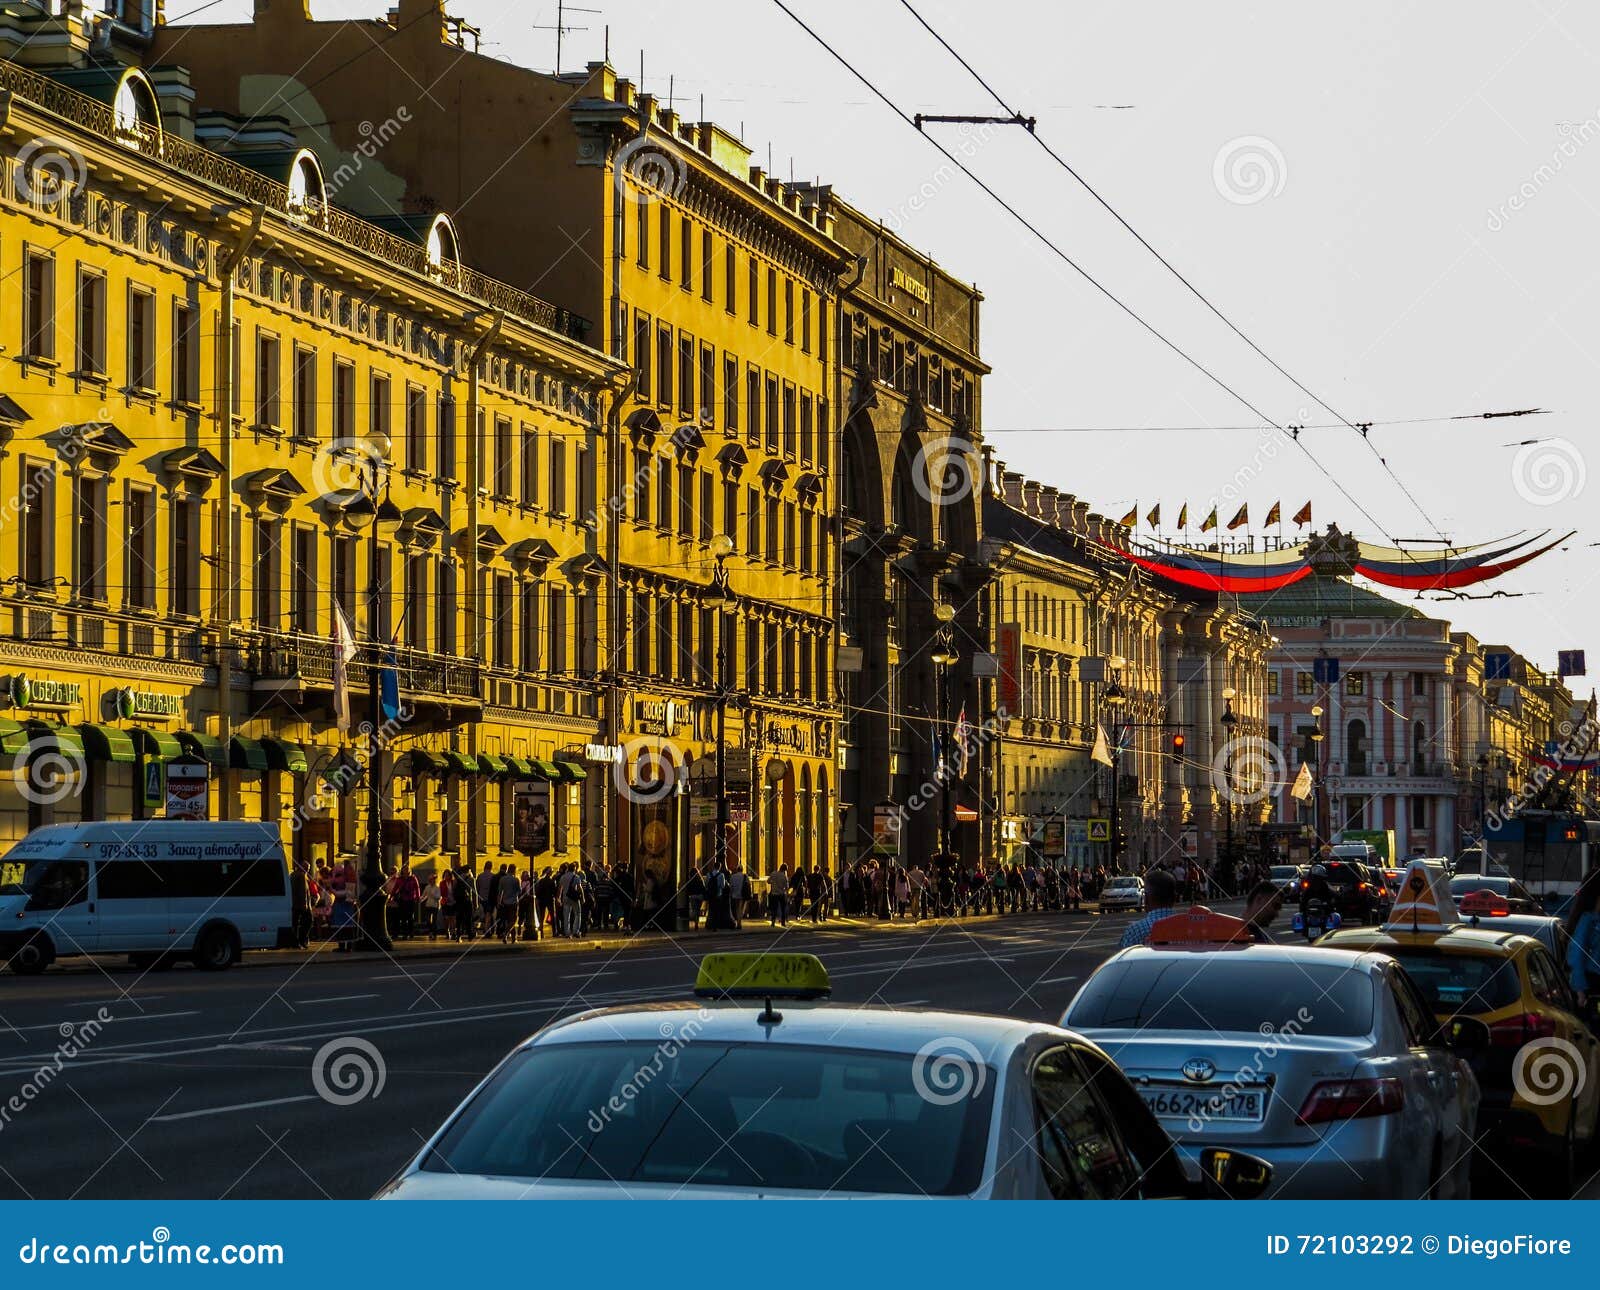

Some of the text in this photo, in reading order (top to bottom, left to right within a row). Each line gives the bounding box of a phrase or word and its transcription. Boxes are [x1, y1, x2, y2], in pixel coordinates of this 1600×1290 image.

[31, 680, 81, 704] СБЕРБАНК
[136, 692, 182, 714] СБЕРБАНК
[642, 700, 666, 721] HOCKEY
[100, 842, 262, 859] 979-33-33 Заказ автобусов
